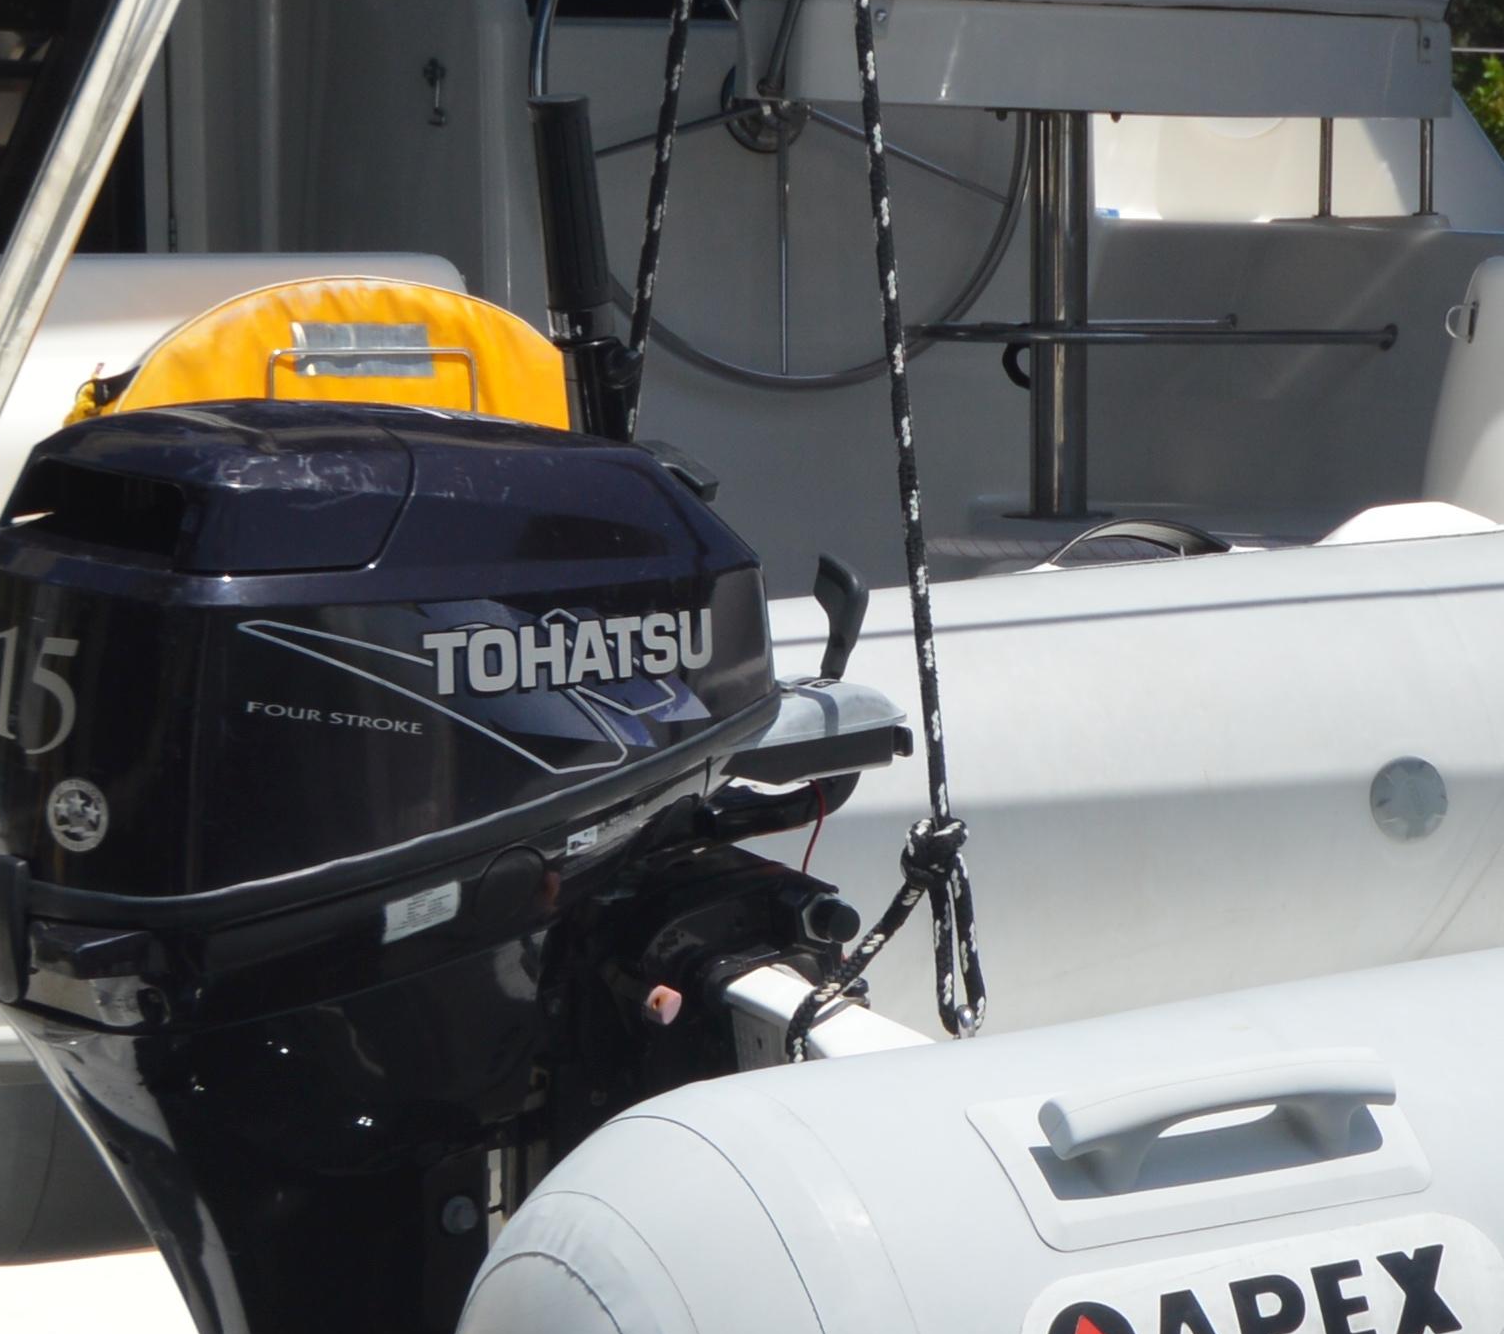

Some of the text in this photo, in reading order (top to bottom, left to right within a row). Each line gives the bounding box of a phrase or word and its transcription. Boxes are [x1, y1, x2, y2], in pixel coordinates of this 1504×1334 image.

[423, 608, 713, 695] TOHATSU
[246, 701, 423, 735] FOUR STROKE
